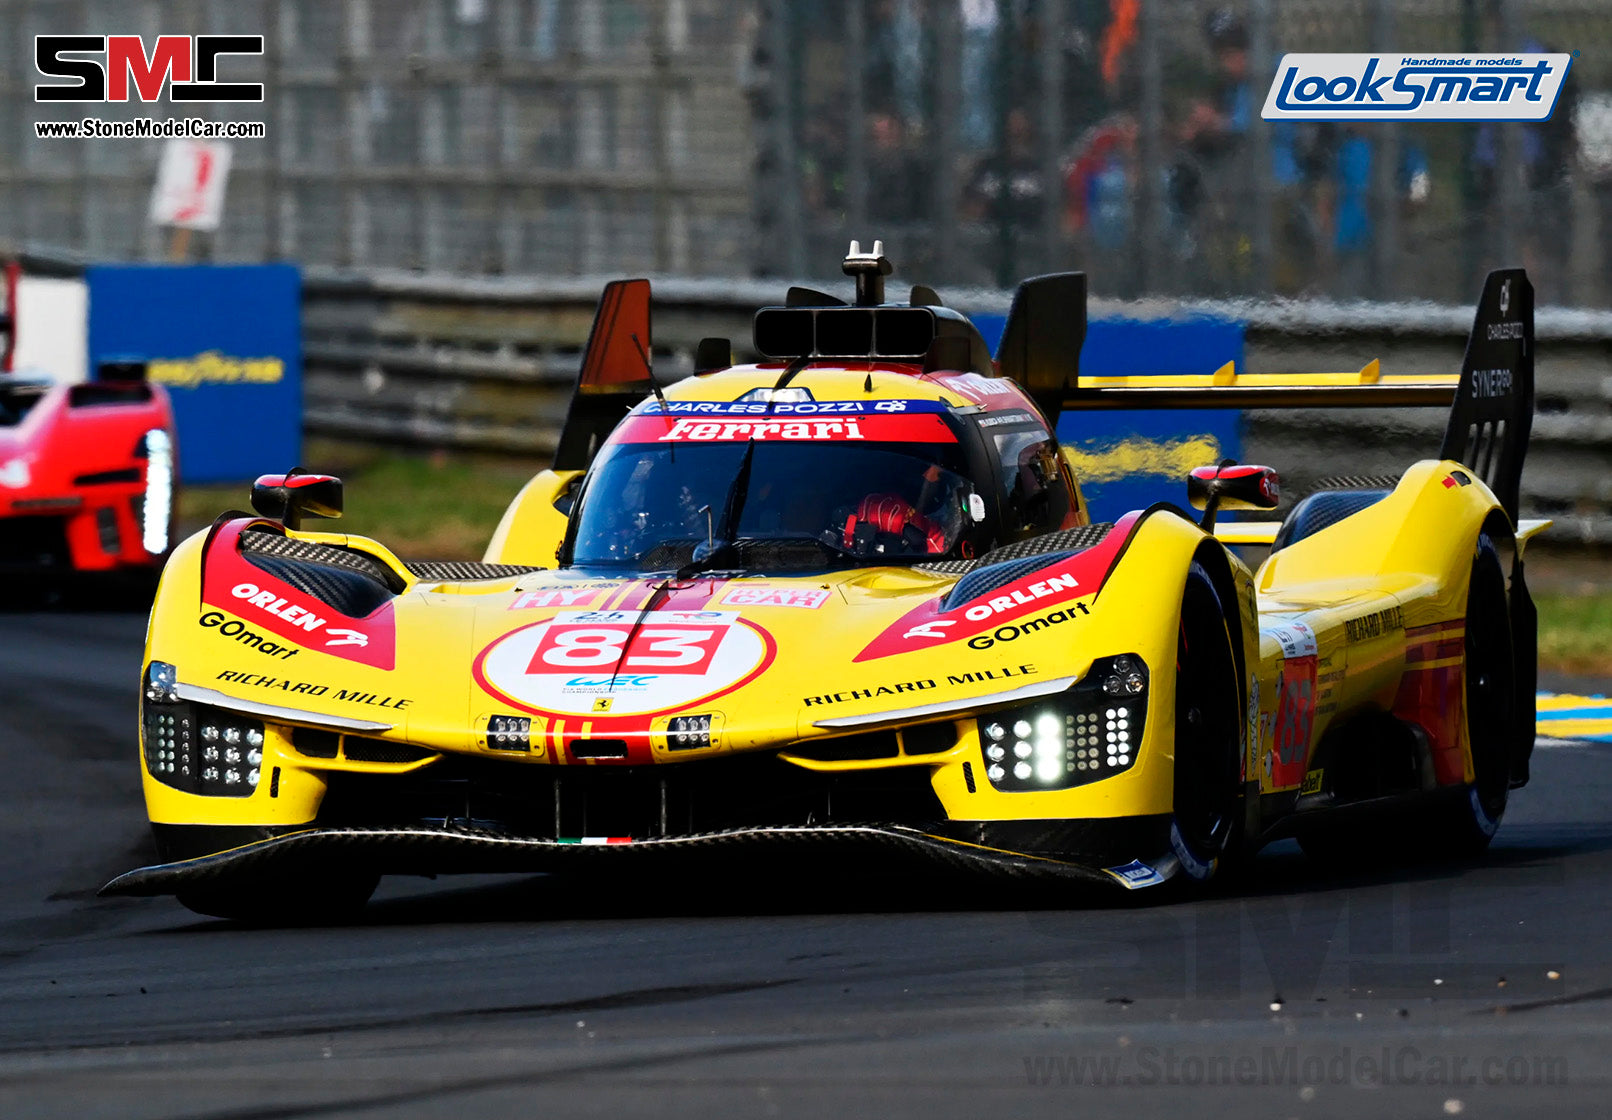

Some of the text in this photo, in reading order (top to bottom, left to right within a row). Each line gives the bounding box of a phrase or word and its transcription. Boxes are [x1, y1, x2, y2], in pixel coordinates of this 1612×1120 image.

[644, 402, 767, 414] CHARLES
[774, 401, 864, 414] POZZI
[658, 417, 865, 441] Ferrari
[231, 583, 327, 632] ORLEN
[514, 590, 597, 608] HY
[729, 595, 817, 607] CAR
[965, 573, 1079, 621] ORLEN
[199, 611, 299, 660] GOmart
[967, 602, 1090, 650] GOmart
[542, 628, 716, 668] 83
[216, 670, 414, 710] RICHARD MILLE
[803, 664, 1039, 707] RICHARD MILLE
[1280, 678, 1312, 766] 83
